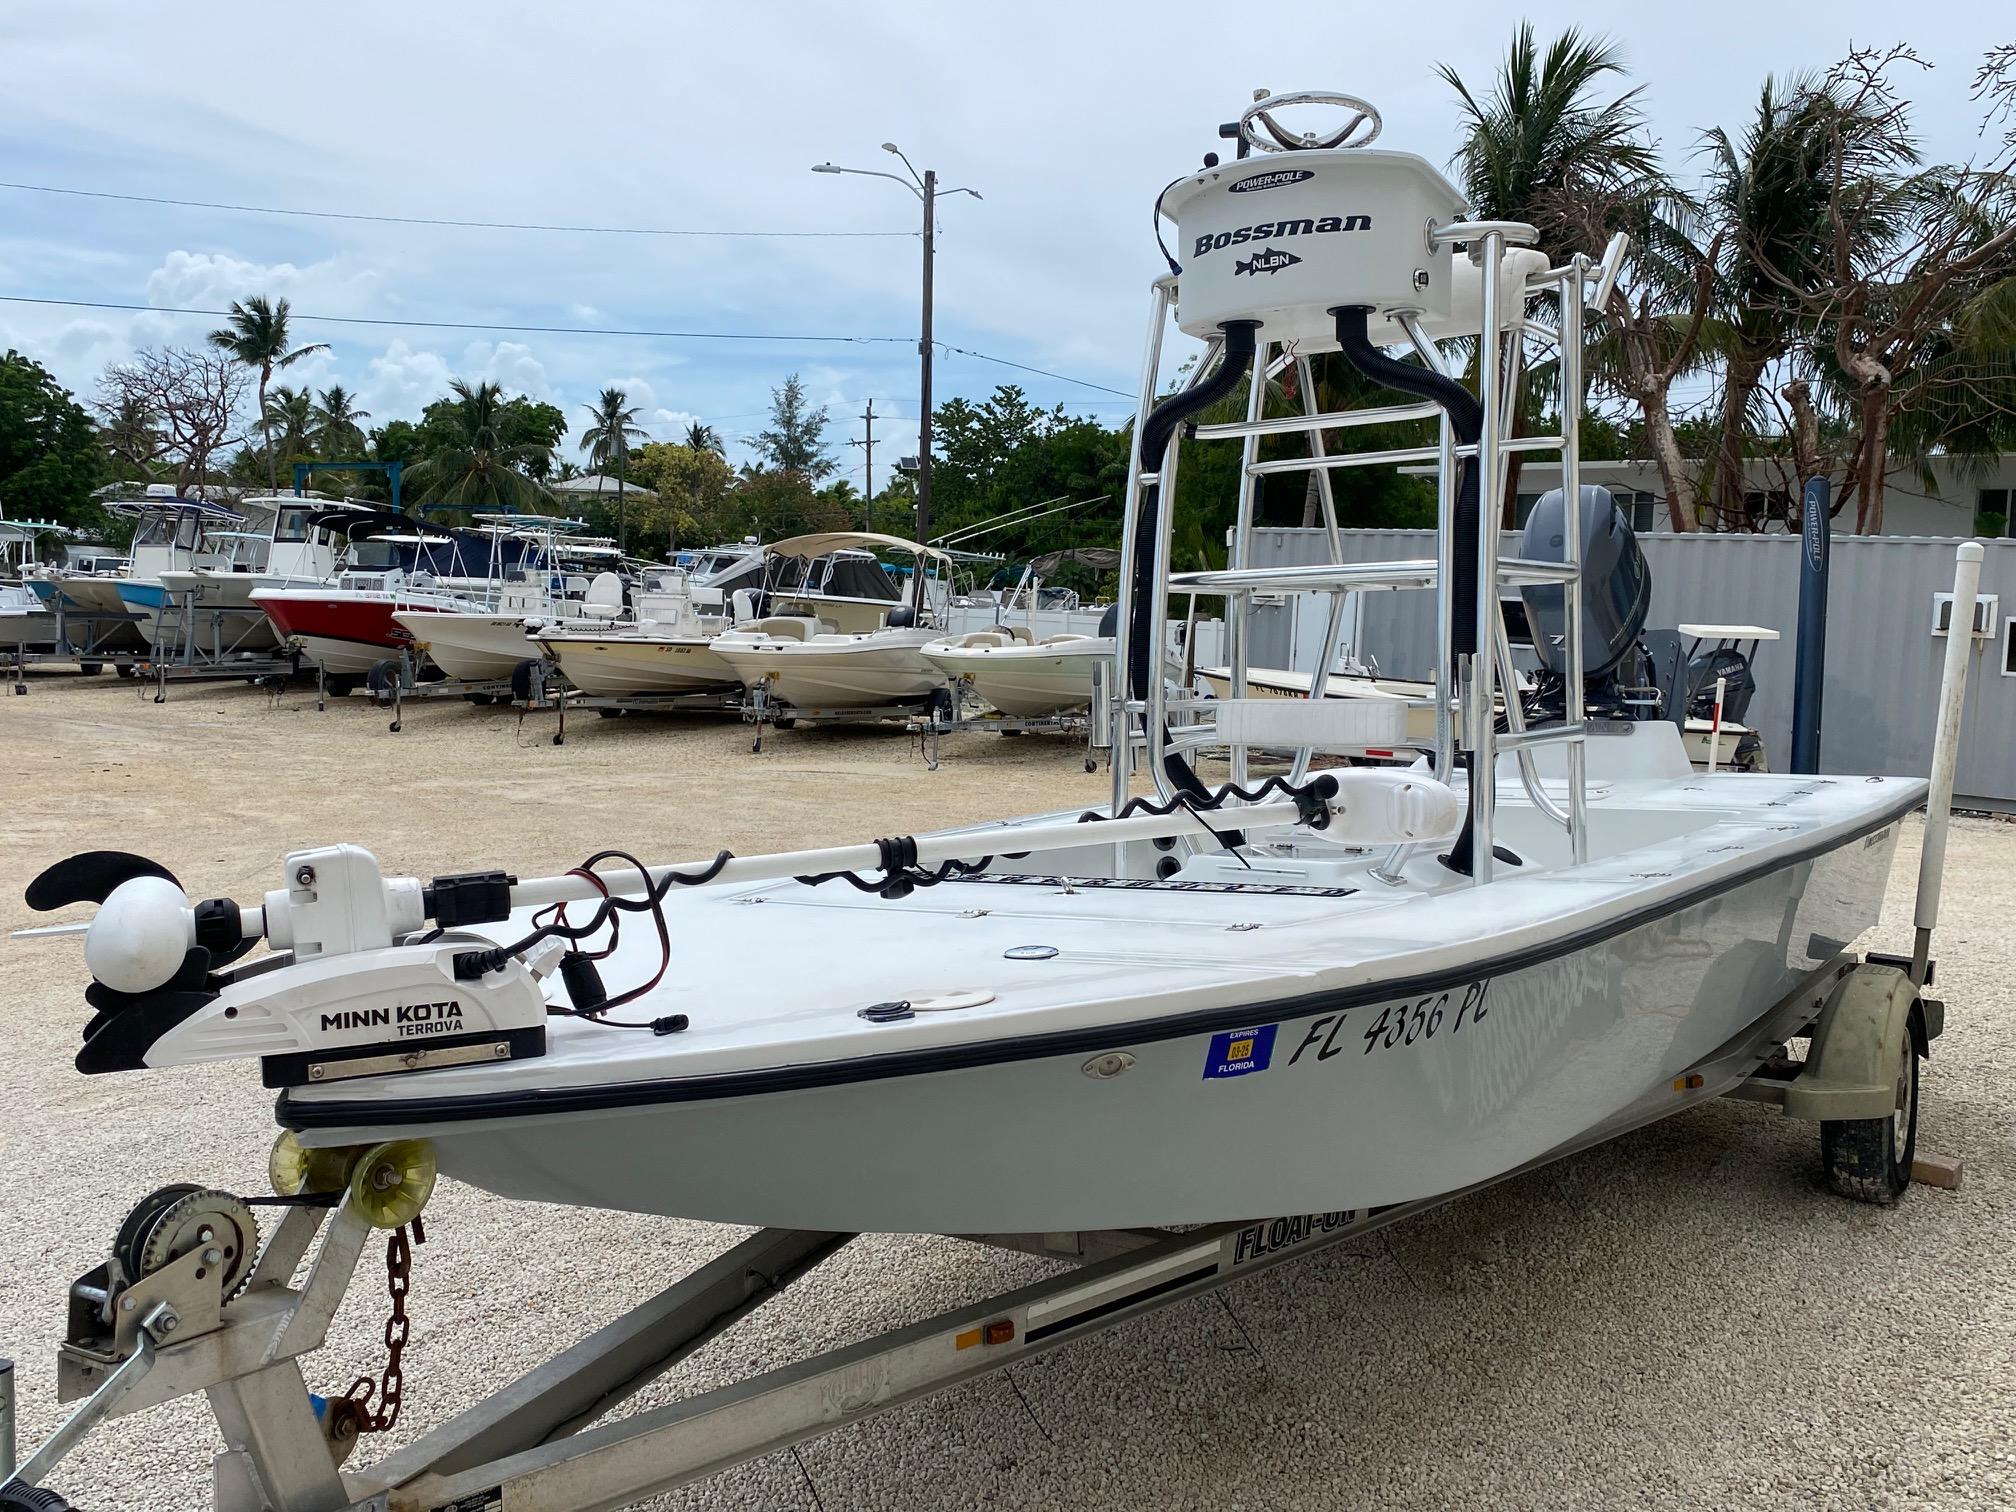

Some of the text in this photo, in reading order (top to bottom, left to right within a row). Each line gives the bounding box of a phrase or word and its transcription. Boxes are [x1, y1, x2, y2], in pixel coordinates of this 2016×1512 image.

[1236, 171, 1304, 190] POWER-POLE
[1193, 214, 1372, 259] Bossman
[1252, 253, 1290, 271] NLBN
[1808, 500, 1821, 561] POWER-POLE
[1716, 662, 1744, 676] YAMAHA
[320, 1001, 463, 1031] MINN KOTA
[1288, 978, 1491, 1067] FL 4356 PL
[397, 1019, 463, 1037] TERROVA
[1229, 1028, 1259, 1039] EXPIRES
[1218, 1060, 1255, 1073] FLORIDA
